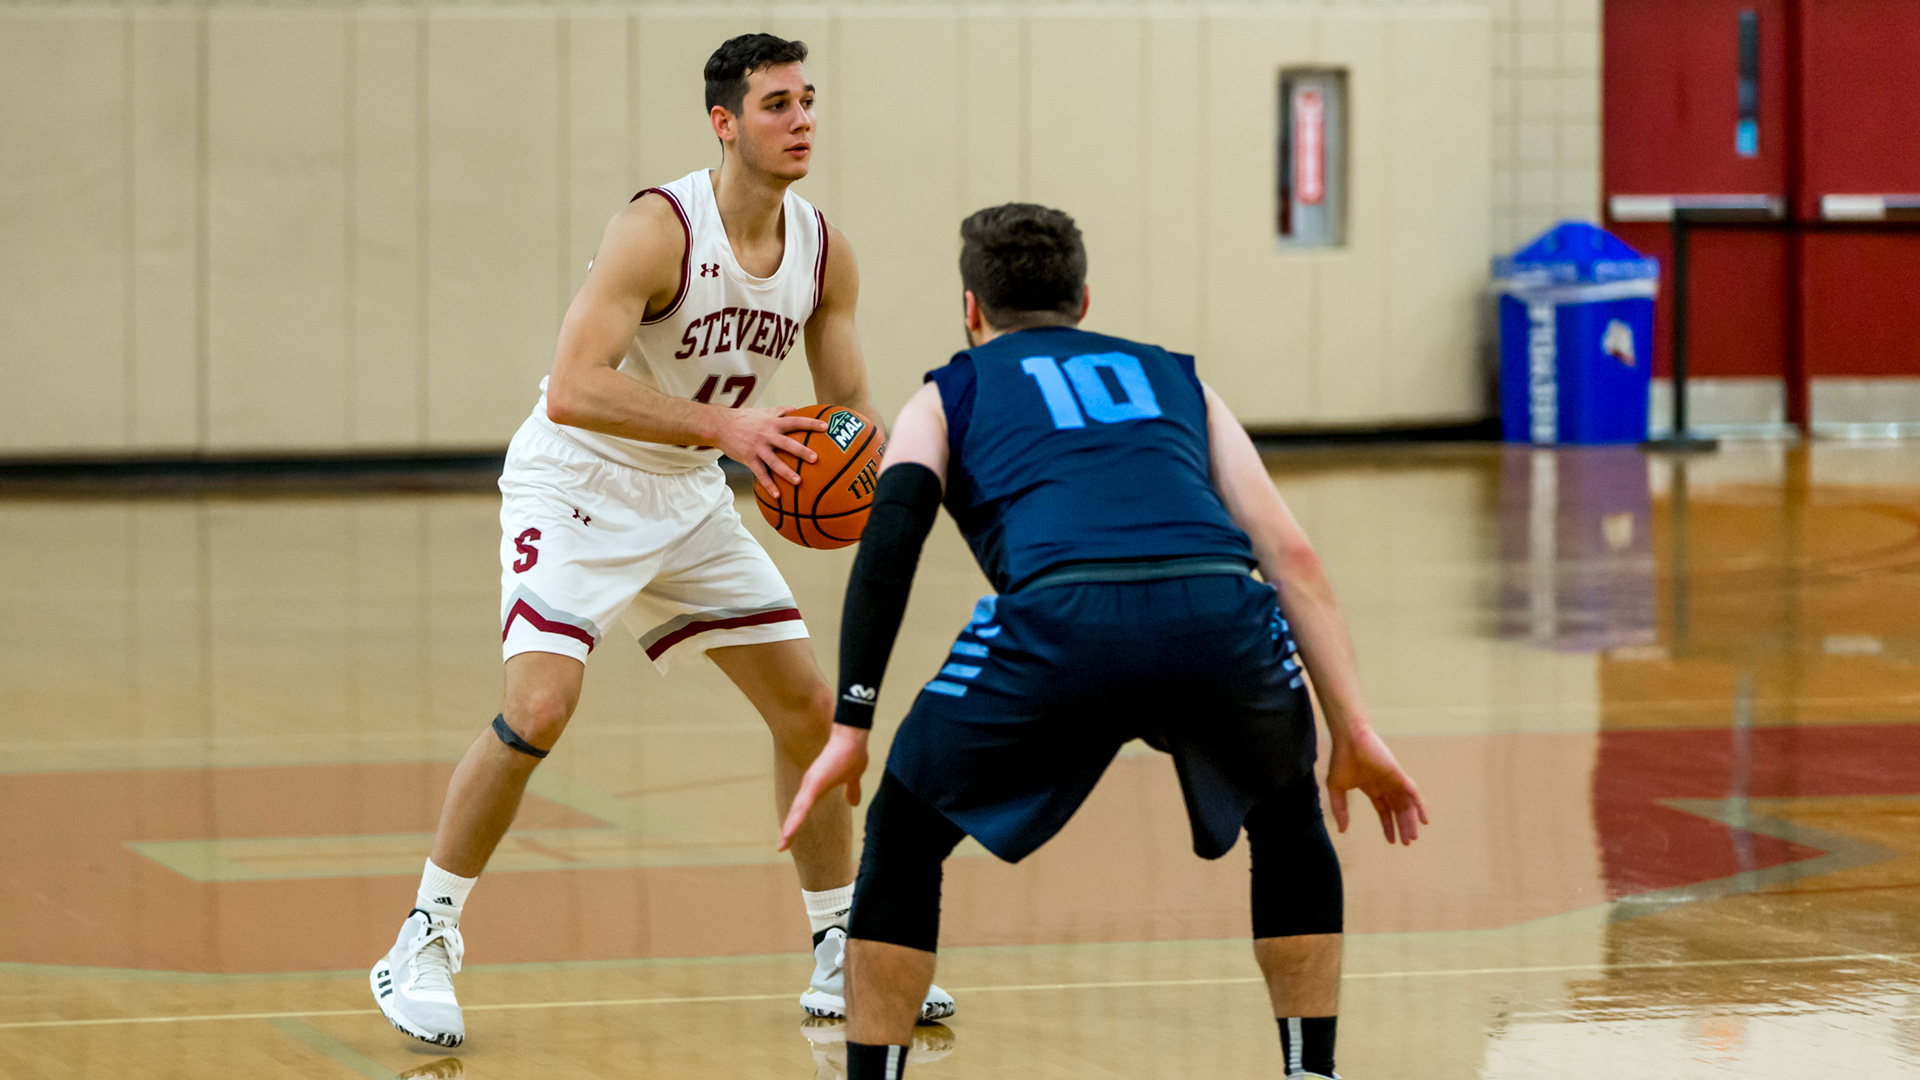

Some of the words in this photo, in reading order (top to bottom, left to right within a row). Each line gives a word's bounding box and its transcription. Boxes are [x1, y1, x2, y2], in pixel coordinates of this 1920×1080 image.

[674, 307, 799, 361] STEVENS
[1020, 351, 1164, 430] 10
[835, 416, 862, 448] MAC
[513, 527, 542, 574] S
